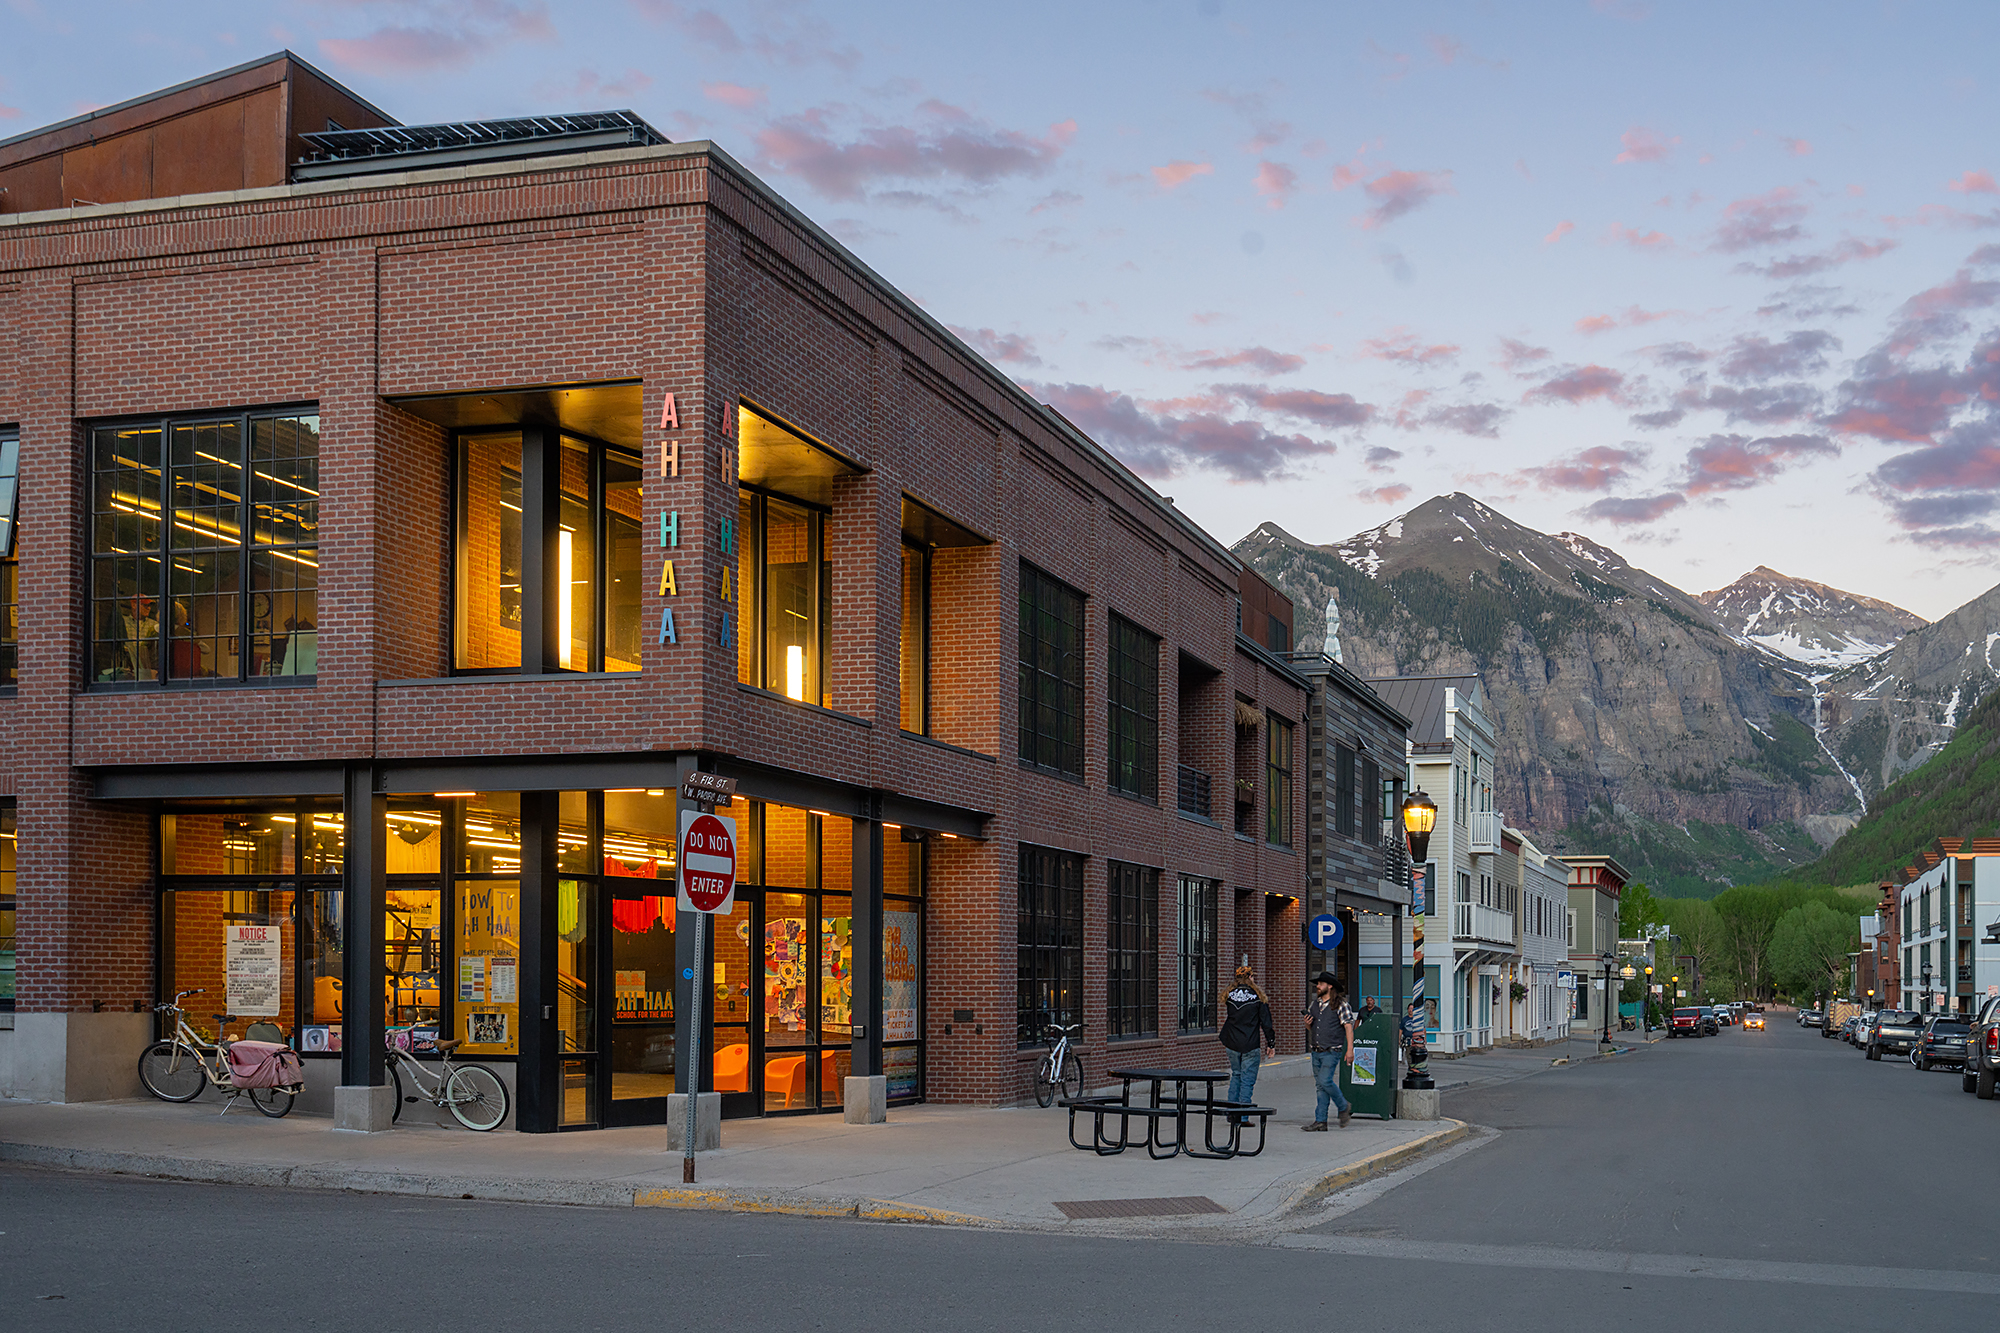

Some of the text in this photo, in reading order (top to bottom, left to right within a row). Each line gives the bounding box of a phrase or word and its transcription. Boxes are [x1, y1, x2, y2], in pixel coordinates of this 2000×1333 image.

[658, 392, 679, 644] AH HAA
[720, 401, 733, 649] AH HAA
[689, 772, 729, 790] S. FIR ST.
[690, 831, 729, 852] DO NOT
[691, 876, 724, 894] ENTER
[462, 888, 514, 911] HOW TO
[463, 905, 512, 937] AH HAA
[238, 927, 267, 939] NOTICE
[1318, 921, 1336, 944] P
[616, 991, 674, 1011] AH HAA
[616, 1011, 637, 1019] SCHOOL
[637, 1011, 649, 1019] FOR
[887, 1020, 913, 1029] TICKETS AT
